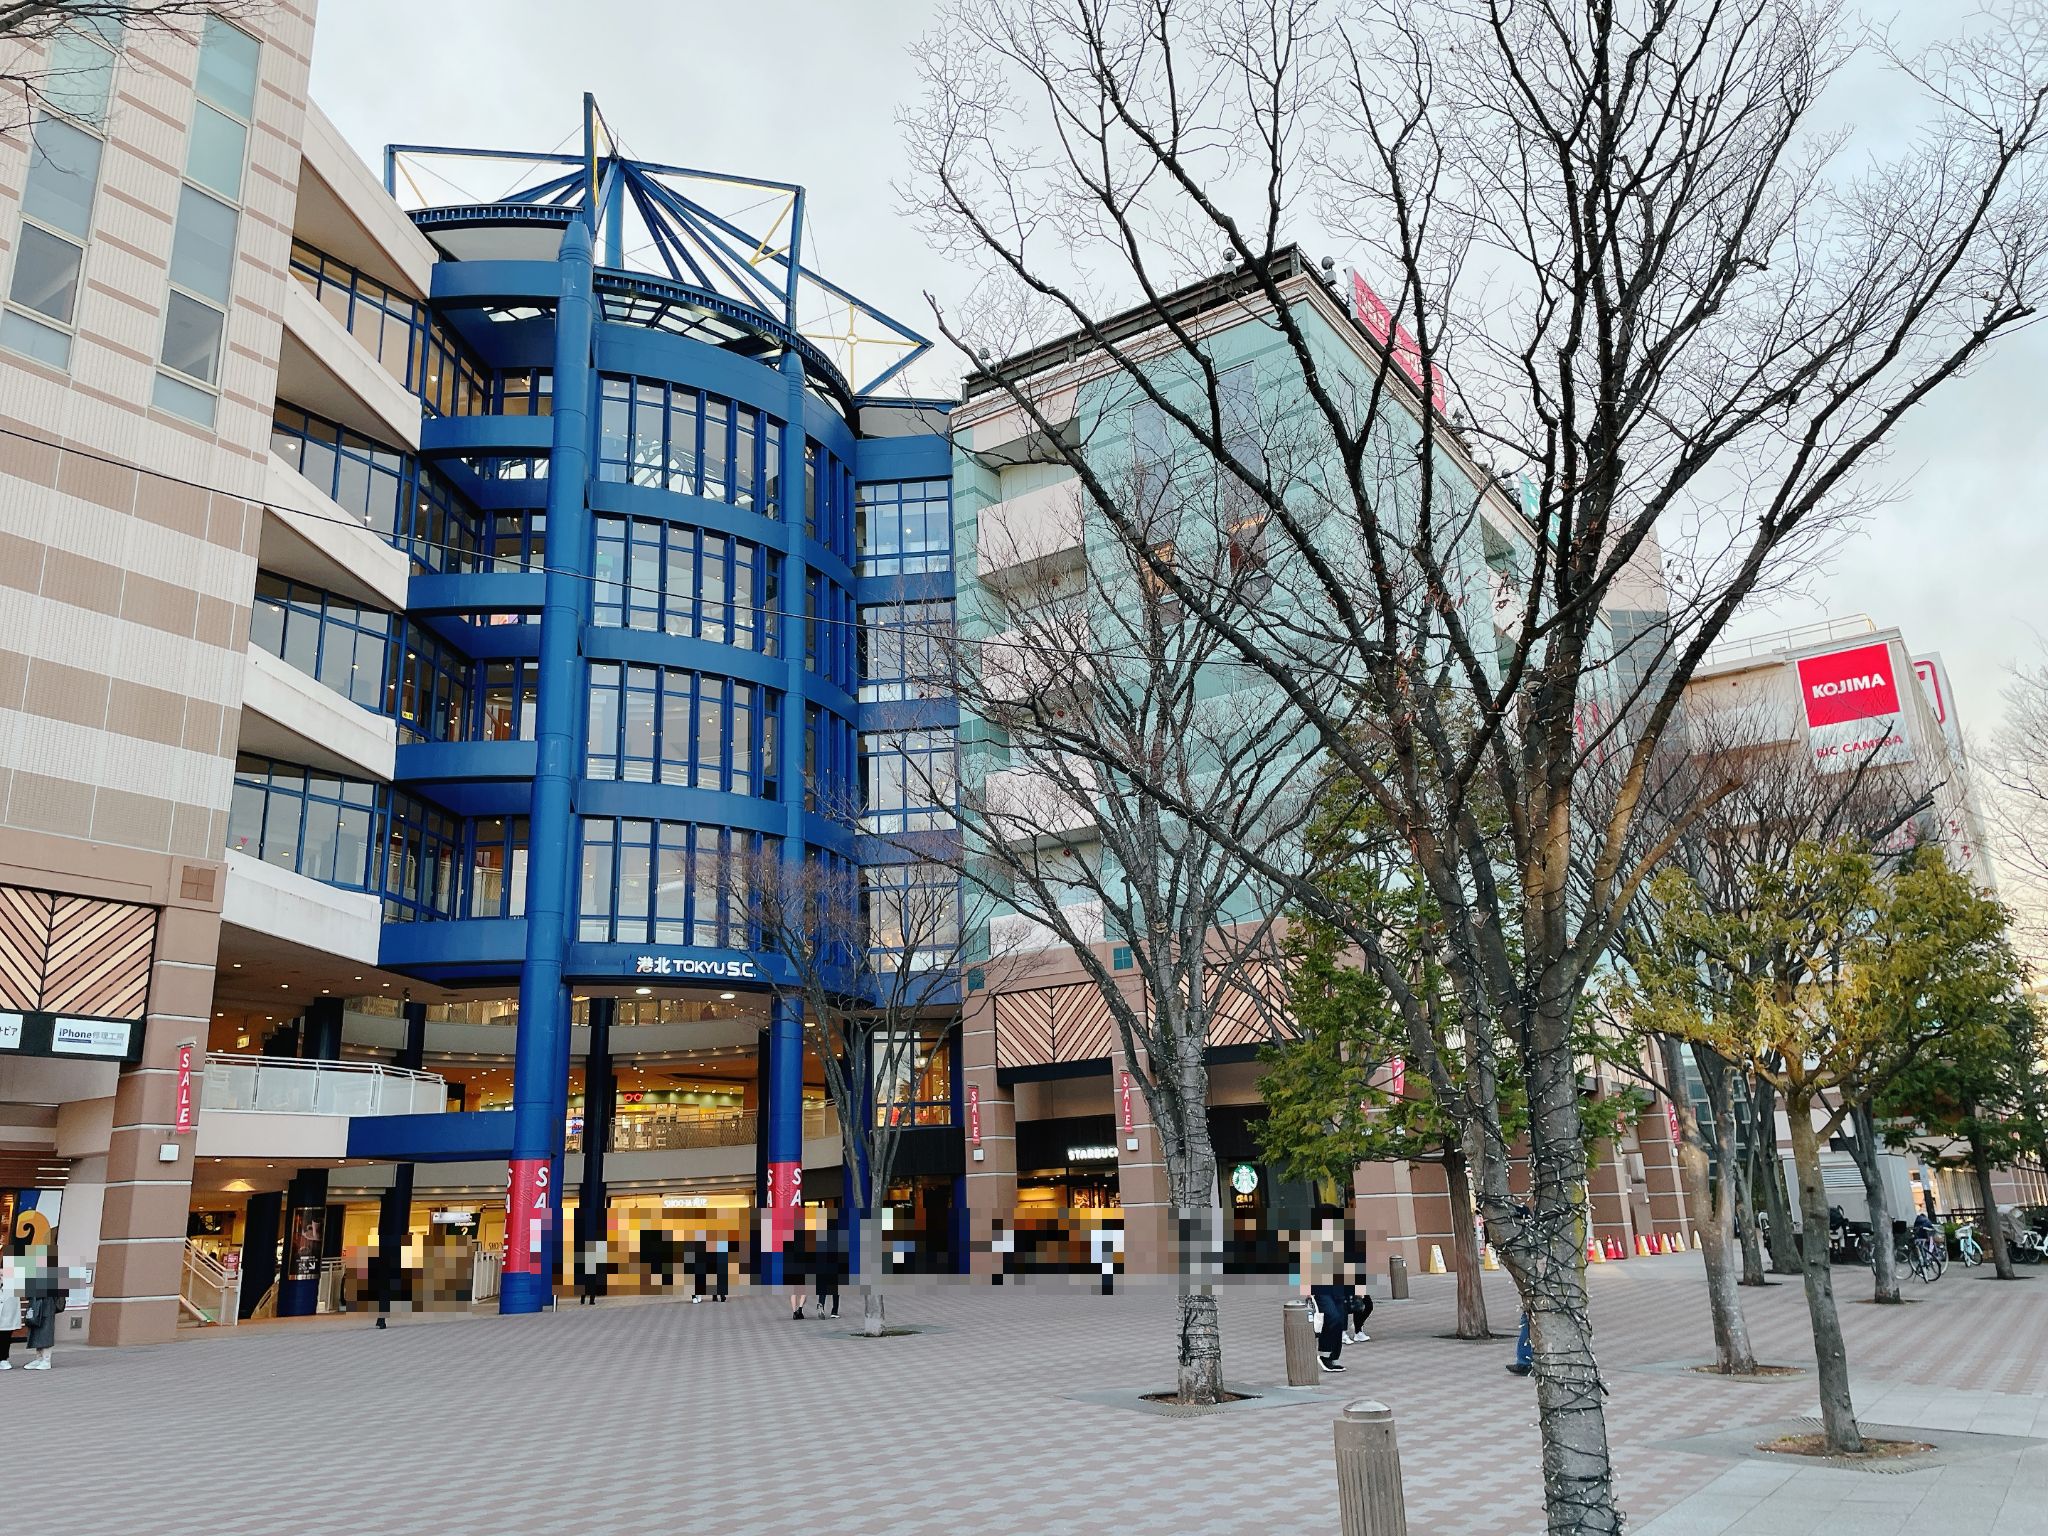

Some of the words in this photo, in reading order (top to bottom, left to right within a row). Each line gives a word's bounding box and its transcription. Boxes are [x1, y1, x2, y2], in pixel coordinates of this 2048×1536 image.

[1812, 673, 1886, 699] KOJIMA
[636, 956, 670, 974] 港北
[672, 959, 725, 975] TOKYU
[179, 1053, 190, 1124] SALE
[1669, 1105, 1678, 1139] SALE
